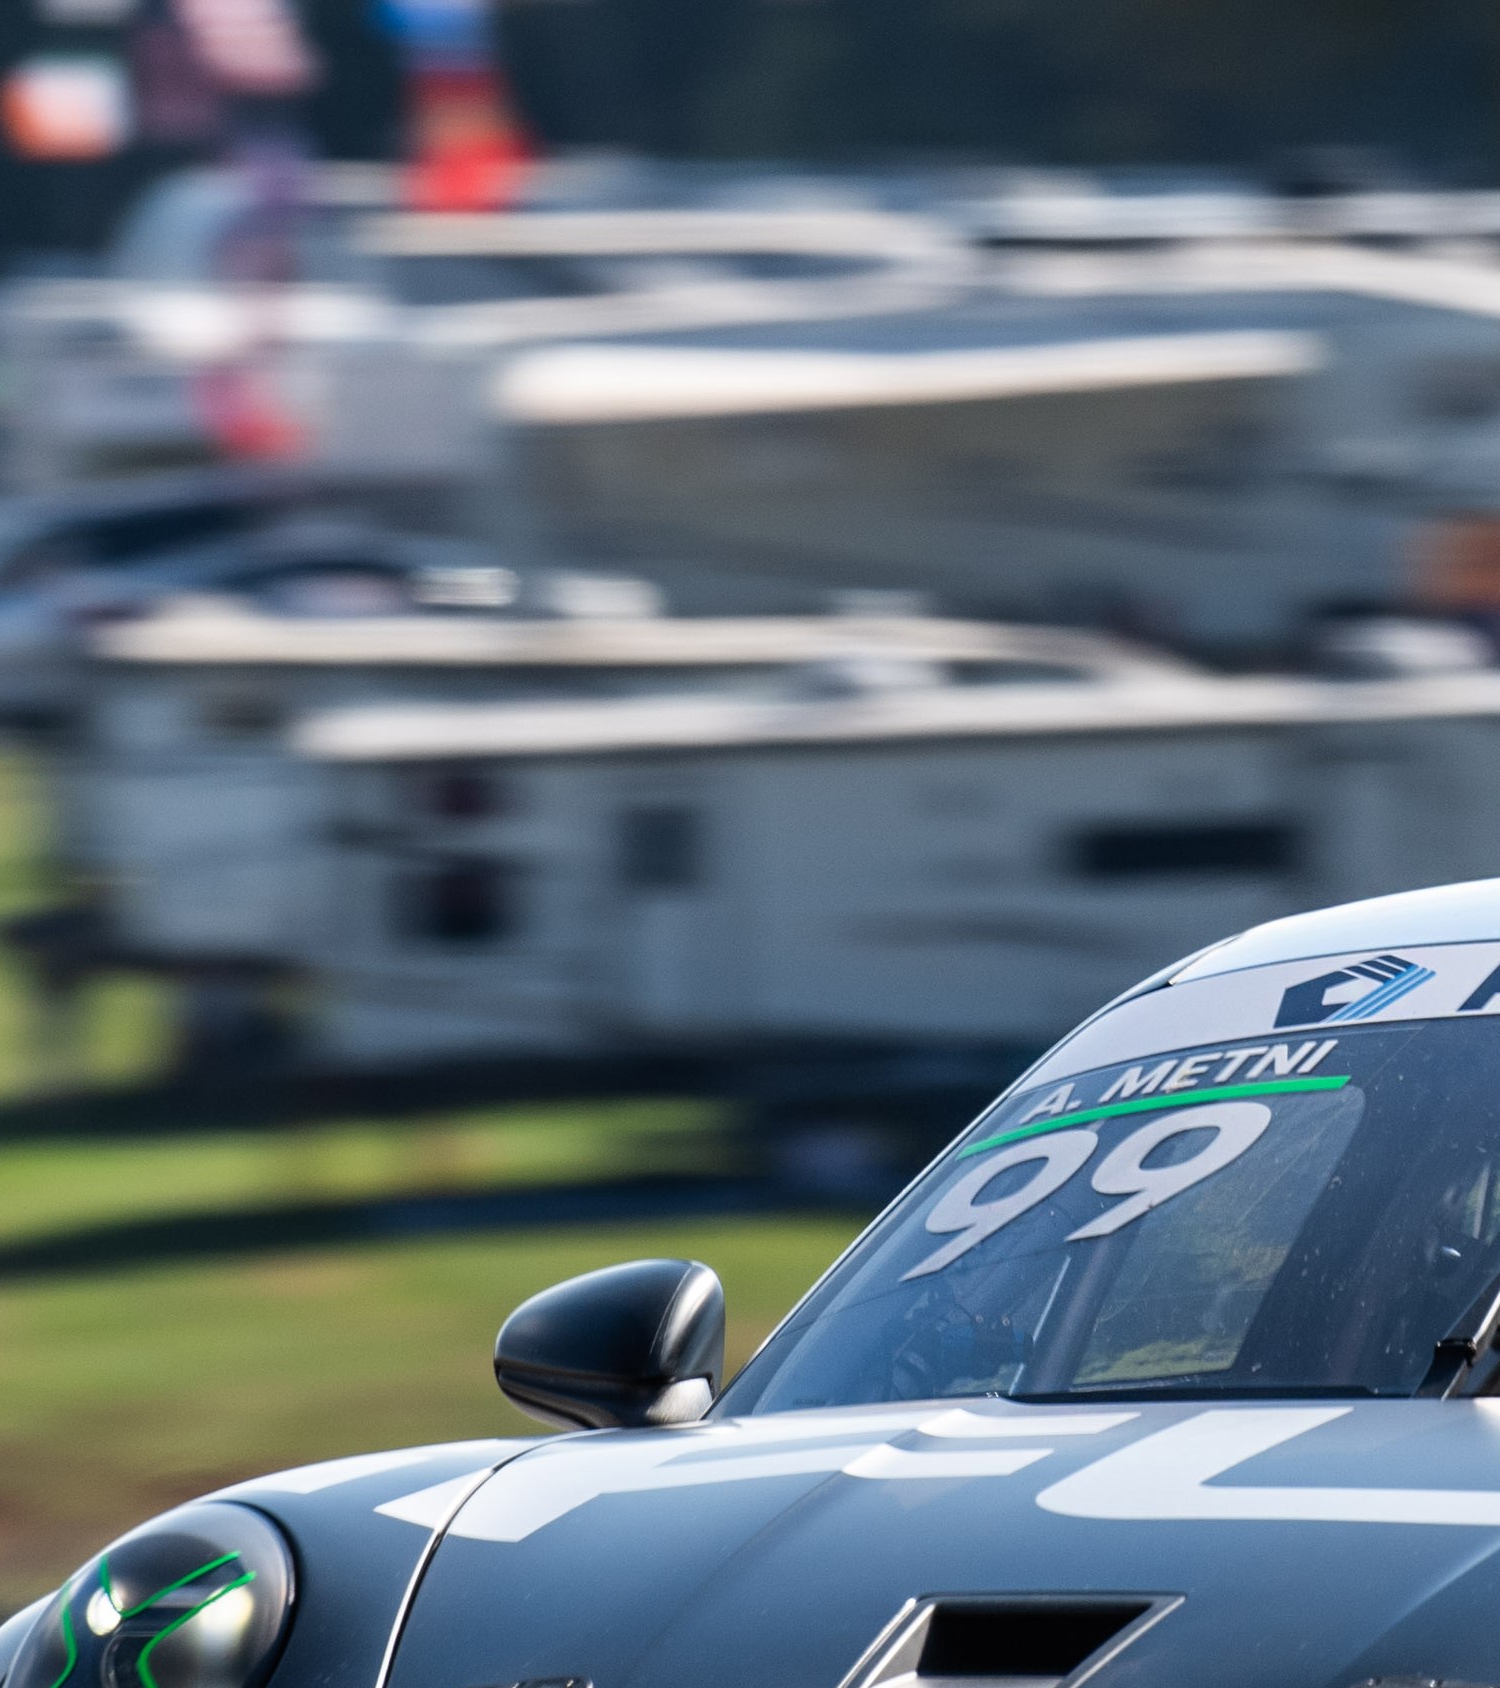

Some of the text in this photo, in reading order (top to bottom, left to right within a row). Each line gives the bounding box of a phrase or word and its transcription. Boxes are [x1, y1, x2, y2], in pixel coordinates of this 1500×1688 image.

[1019, 1039, 1338, 1124] A. METNI
[899, 1101, 1272, 1282] 99
